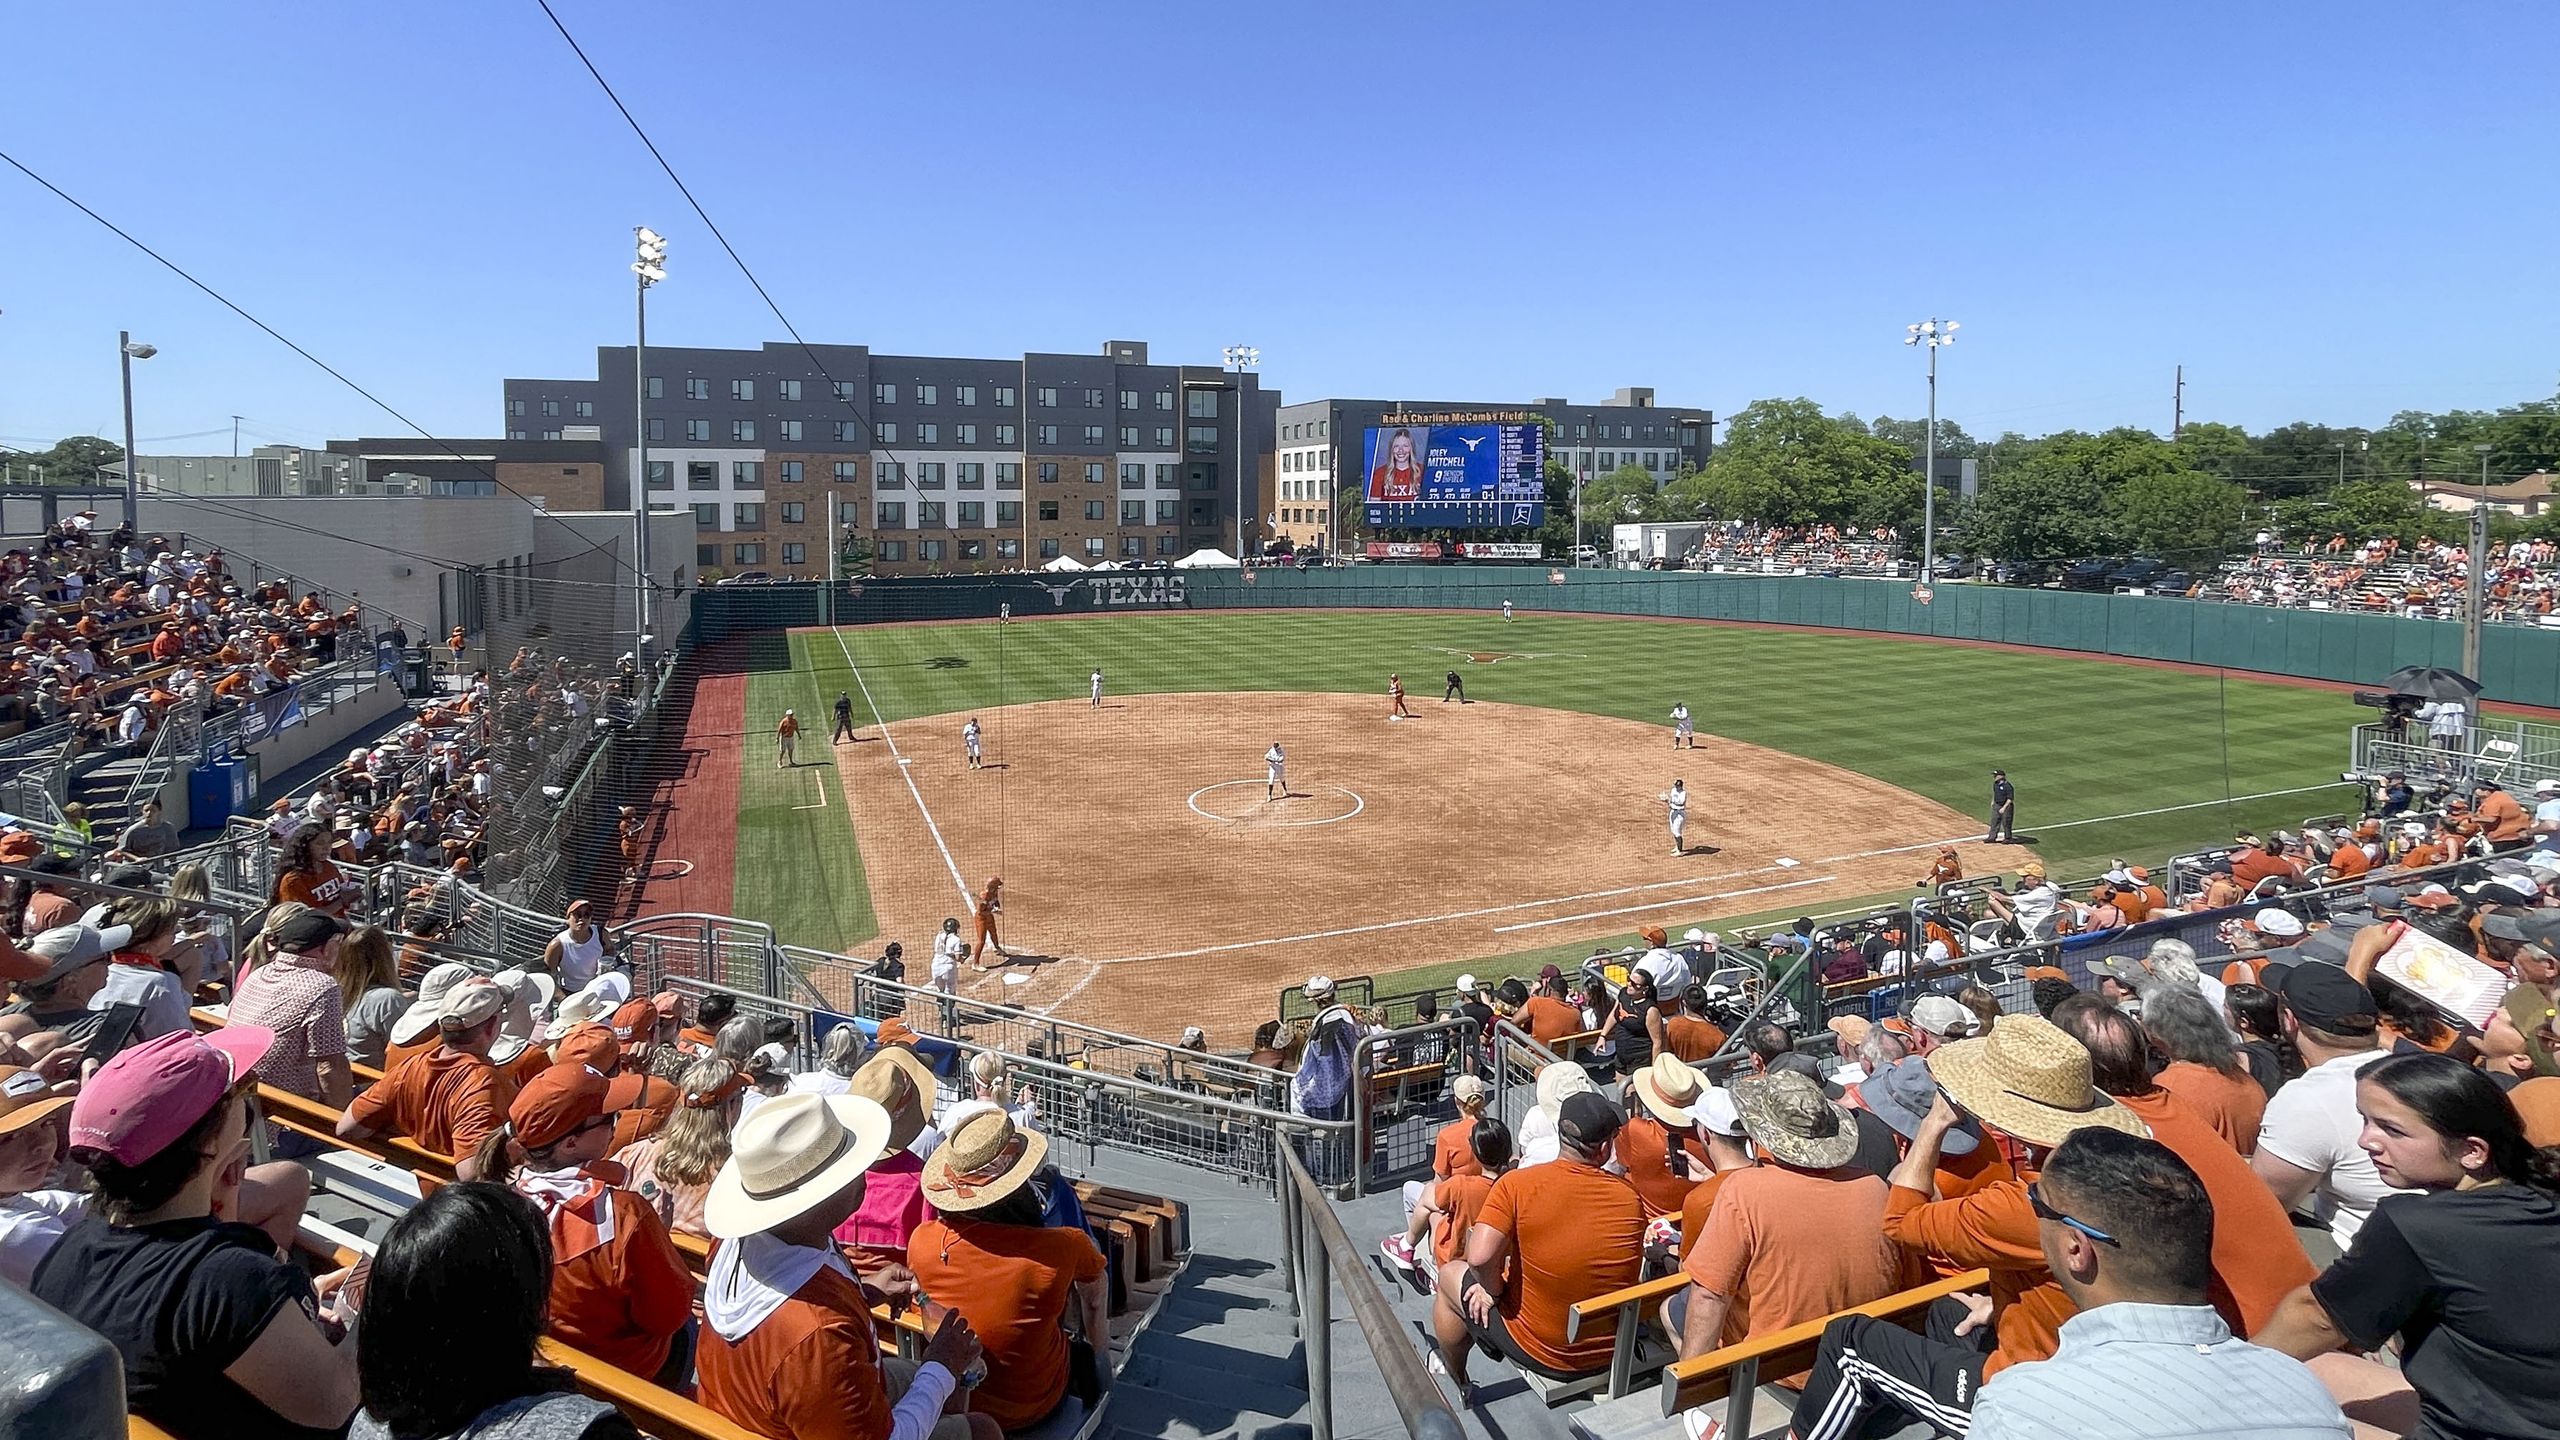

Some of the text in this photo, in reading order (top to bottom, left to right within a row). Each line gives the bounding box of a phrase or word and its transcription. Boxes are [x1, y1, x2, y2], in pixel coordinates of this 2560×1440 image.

[1383, 411, 1523, 424] Red & Charline McCombs Field
[1428, 457, 1465, 467] MITCHELL
[1433, 470, 1443, 483] 9
[1088, 576, 1184, 604] TEXAS
[1957, 1368, 1967, 1403] adidas
